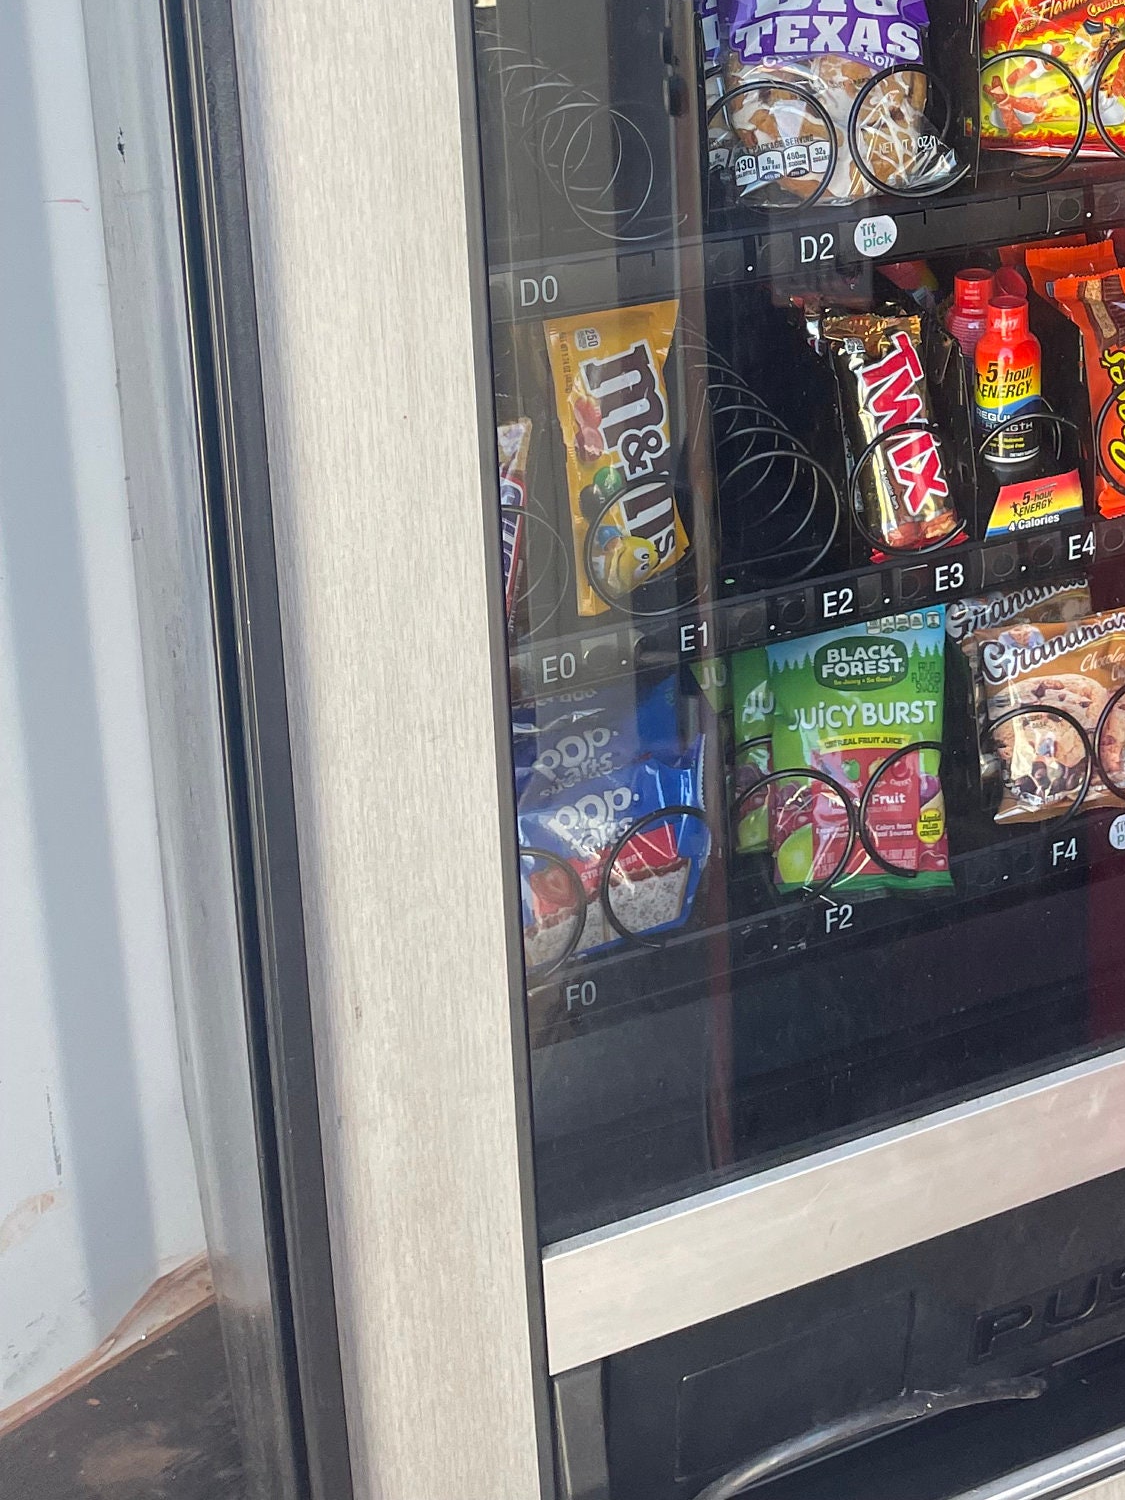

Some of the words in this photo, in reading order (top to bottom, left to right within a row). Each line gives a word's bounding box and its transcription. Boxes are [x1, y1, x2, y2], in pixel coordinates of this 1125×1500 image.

[735, 16, 921, 60] TEXAS
[801, 234, 835, 262] D2
[863, 232, 892, 248] pick
[520, 276, 558, 305] D0
[986, 363, 1034, 383] 5-hour
[981, 378, 1032, 398] ENERGY
[861, 331, 948, 515] TWIX
[1019, 500, 1053, 517] ENERGY
[1022, 491, 1054, 506] 5-hour
[1009, 521, 1015, 532] 4
[1018, 513, 1060, 530] Calories
[1068, 533, 1095, 560] E4
[934, 564, 963, 590] E3
[823, 588, 853, 618] E2
[680, 623, 709, 652] E1
[827, 645, 896, 661] BLACK
[542, 653, 575, 683] E0
[821, 659, 902, 678] FOREST
[788, 702, 857, 731] JUICY
[861, 701, 937, 726] BURST
[1053, 838, 1078, 866] F4
[826, 906, 853, 934] F2
[565, 982, 596, 1010] F0
